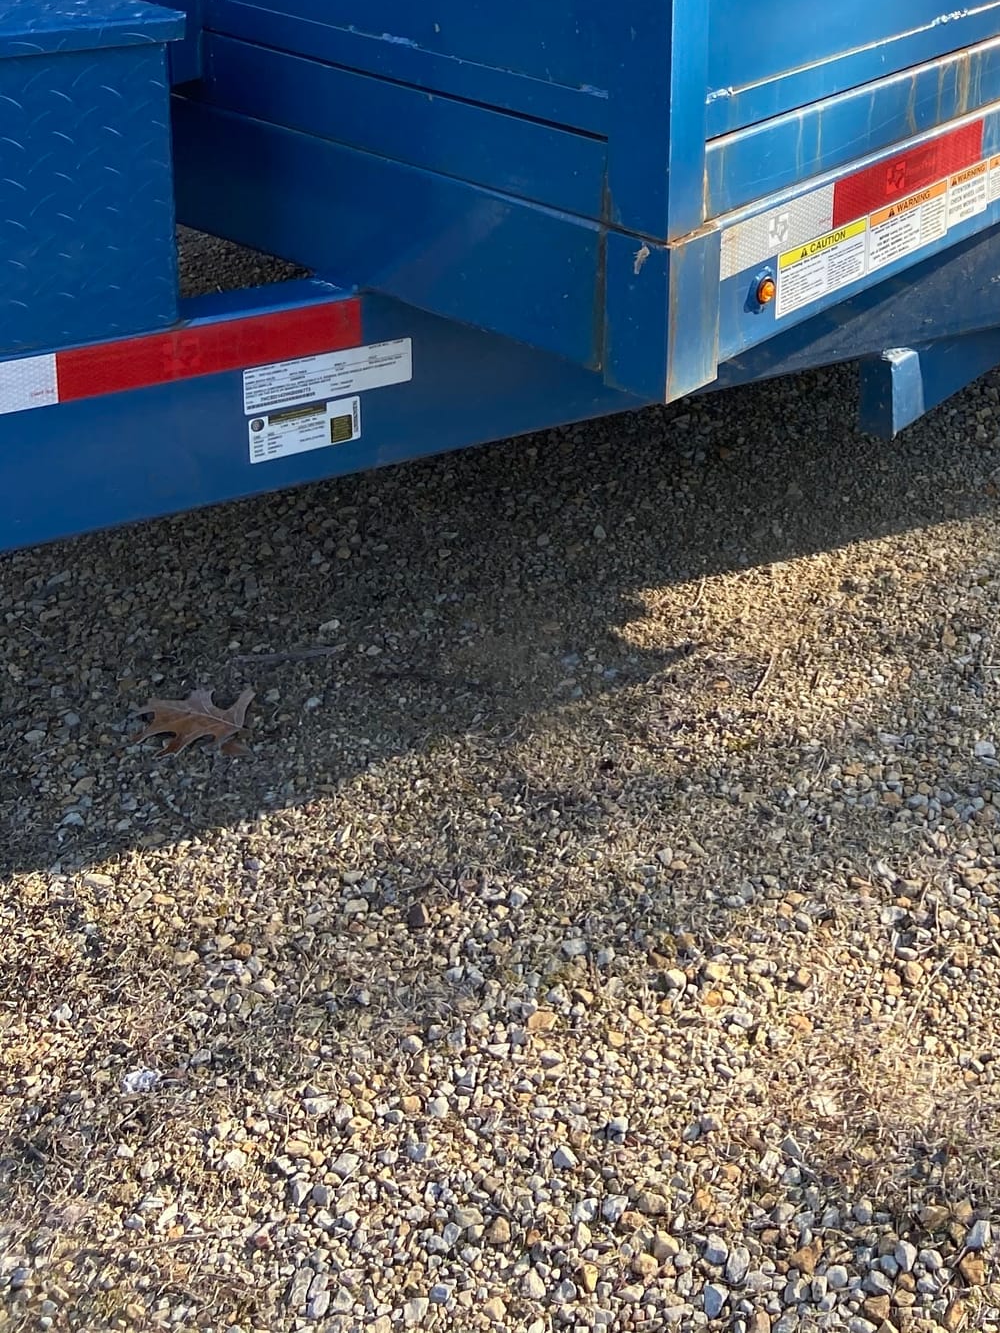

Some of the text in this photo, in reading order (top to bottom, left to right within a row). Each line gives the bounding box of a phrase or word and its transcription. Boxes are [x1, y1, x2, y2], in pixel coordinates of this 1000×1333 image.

[958, 165, 985, 183] WARNING
[897, 191, 930, 213] WARNING
[810, 231, 846, 253] CAUTION
